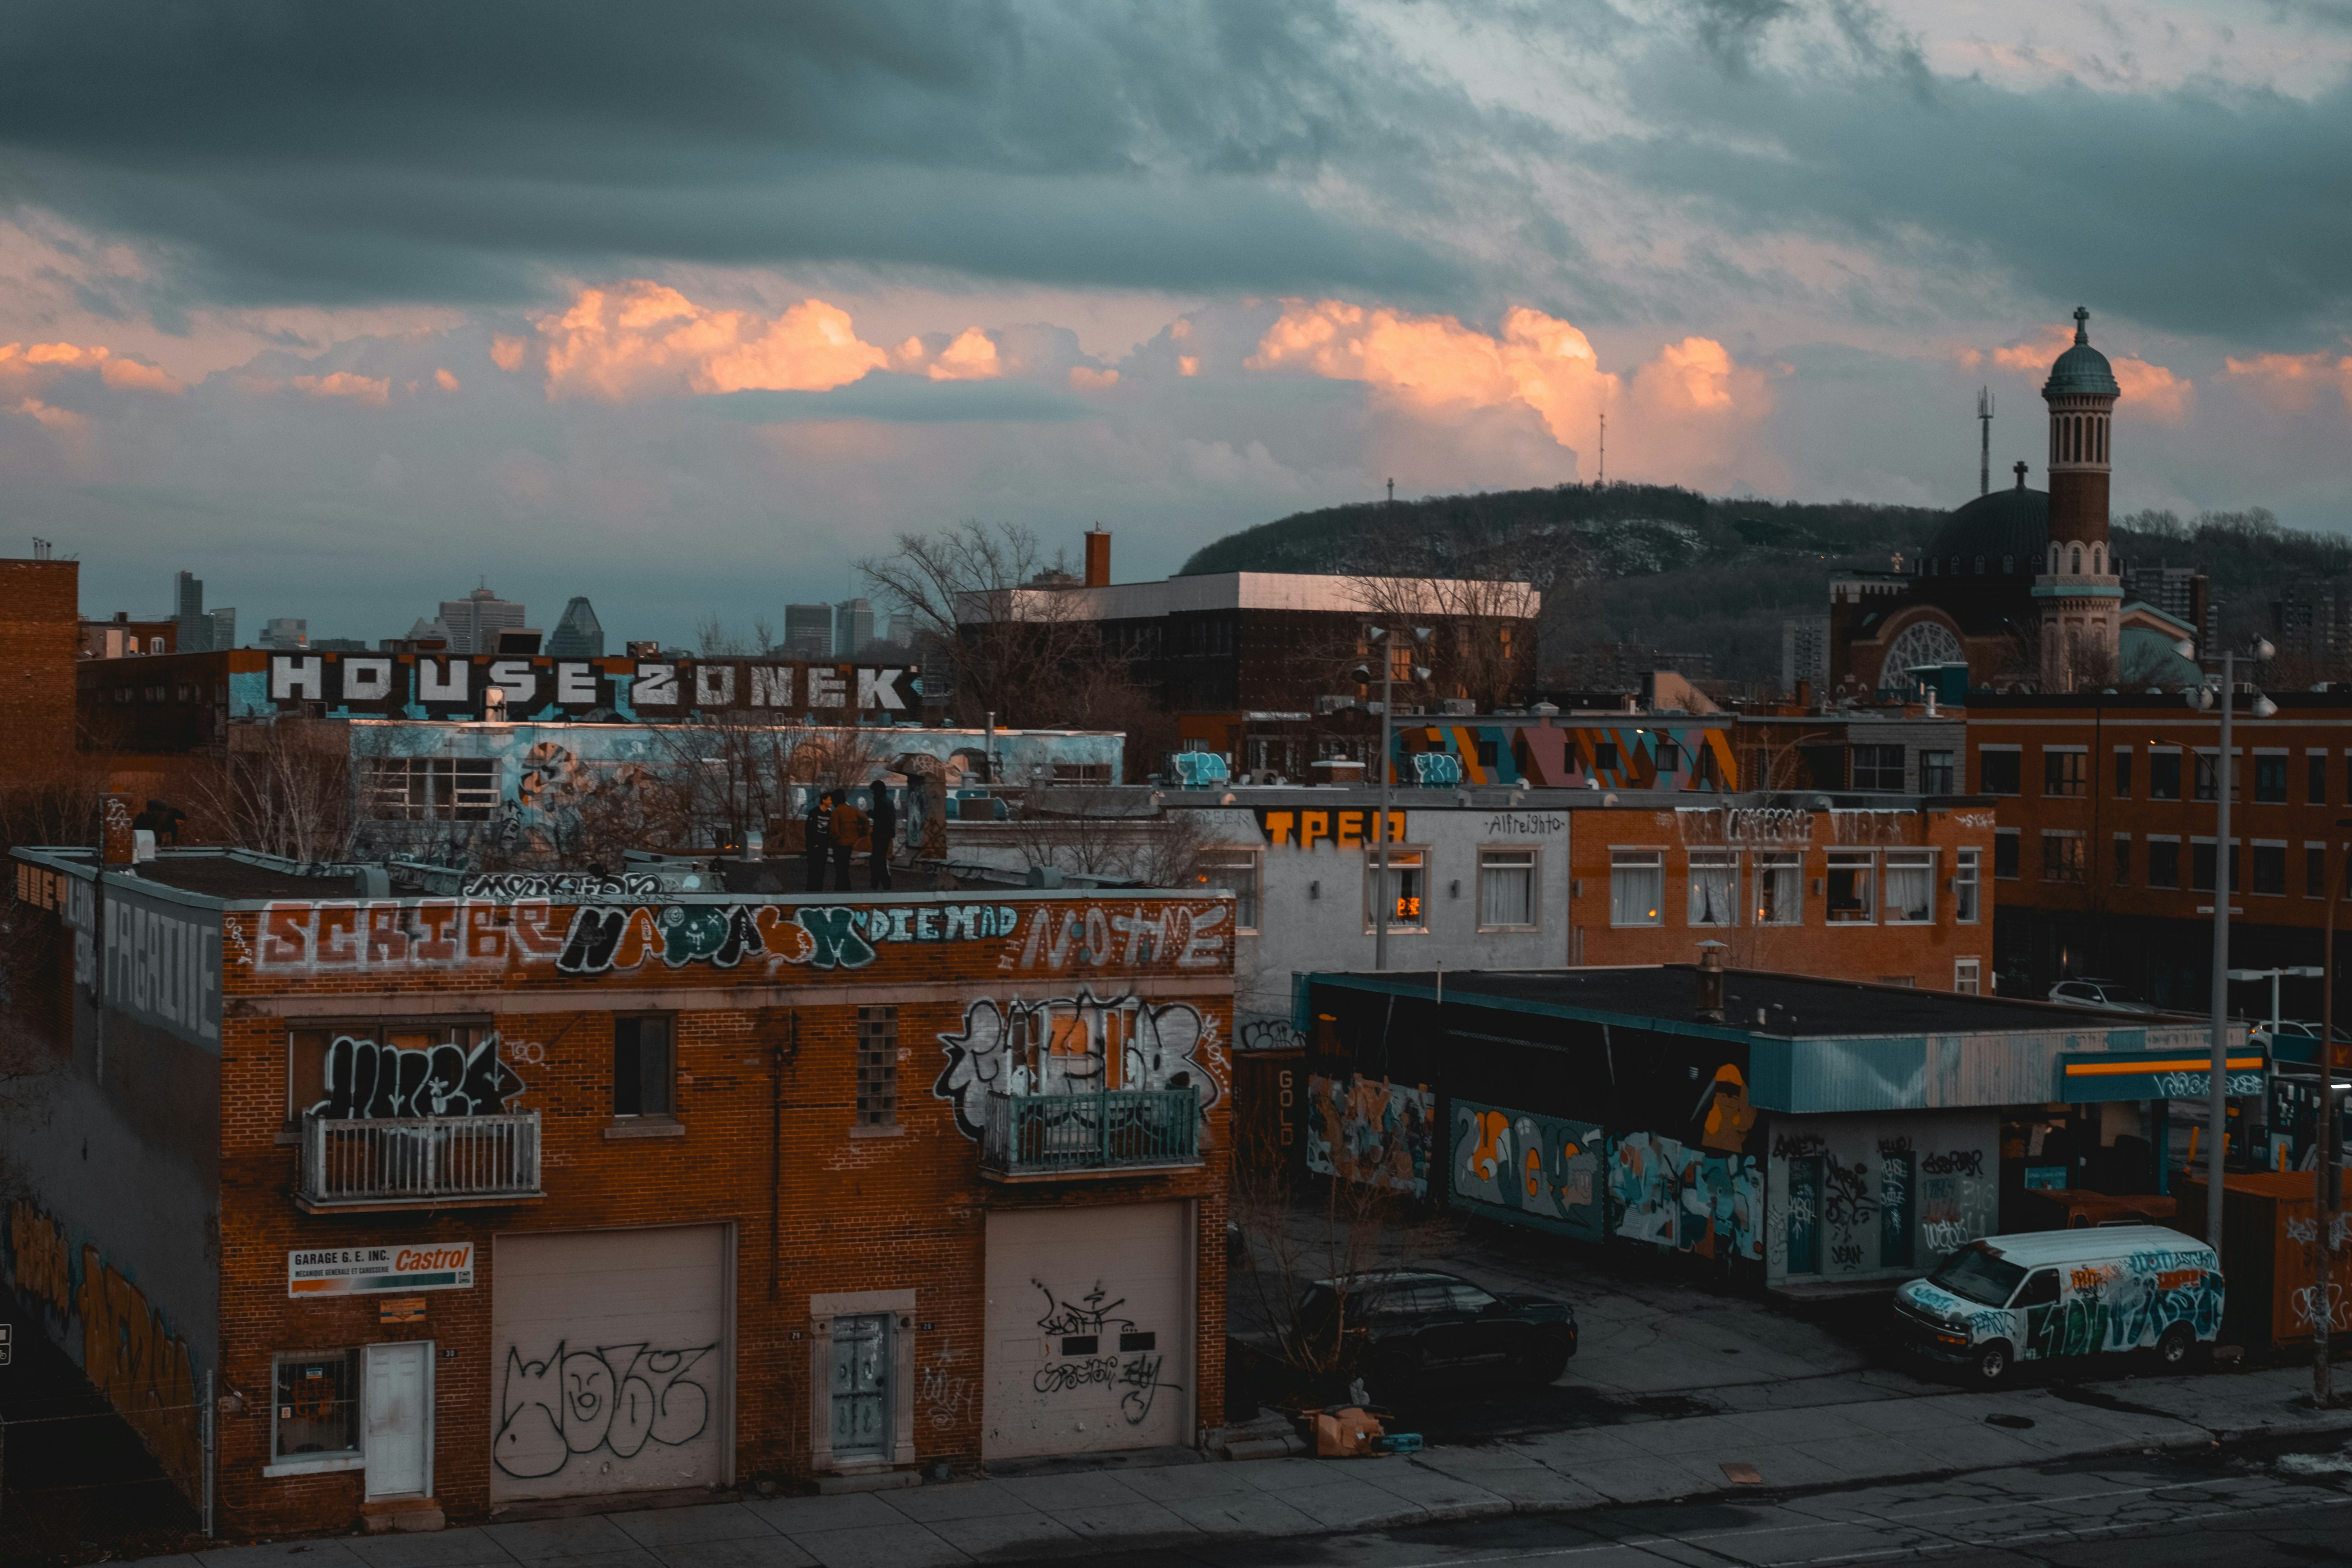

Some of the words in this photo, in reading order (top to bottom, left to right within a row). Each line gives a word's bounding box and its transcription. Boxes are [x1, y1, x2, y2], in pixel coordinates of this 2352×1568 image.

[271, 656, 596, 704] HOUSE
[1278, 1070, 1294, 1146] GOLD
[295, 1252, 337, 1265] GARAGE
[342, 1251, 352, 1263] G.
[355, 1251, 364, 1262] E.
[368, 1250, 390, 1261] INC.
[395, 1247, 469, 1271] Castrol
